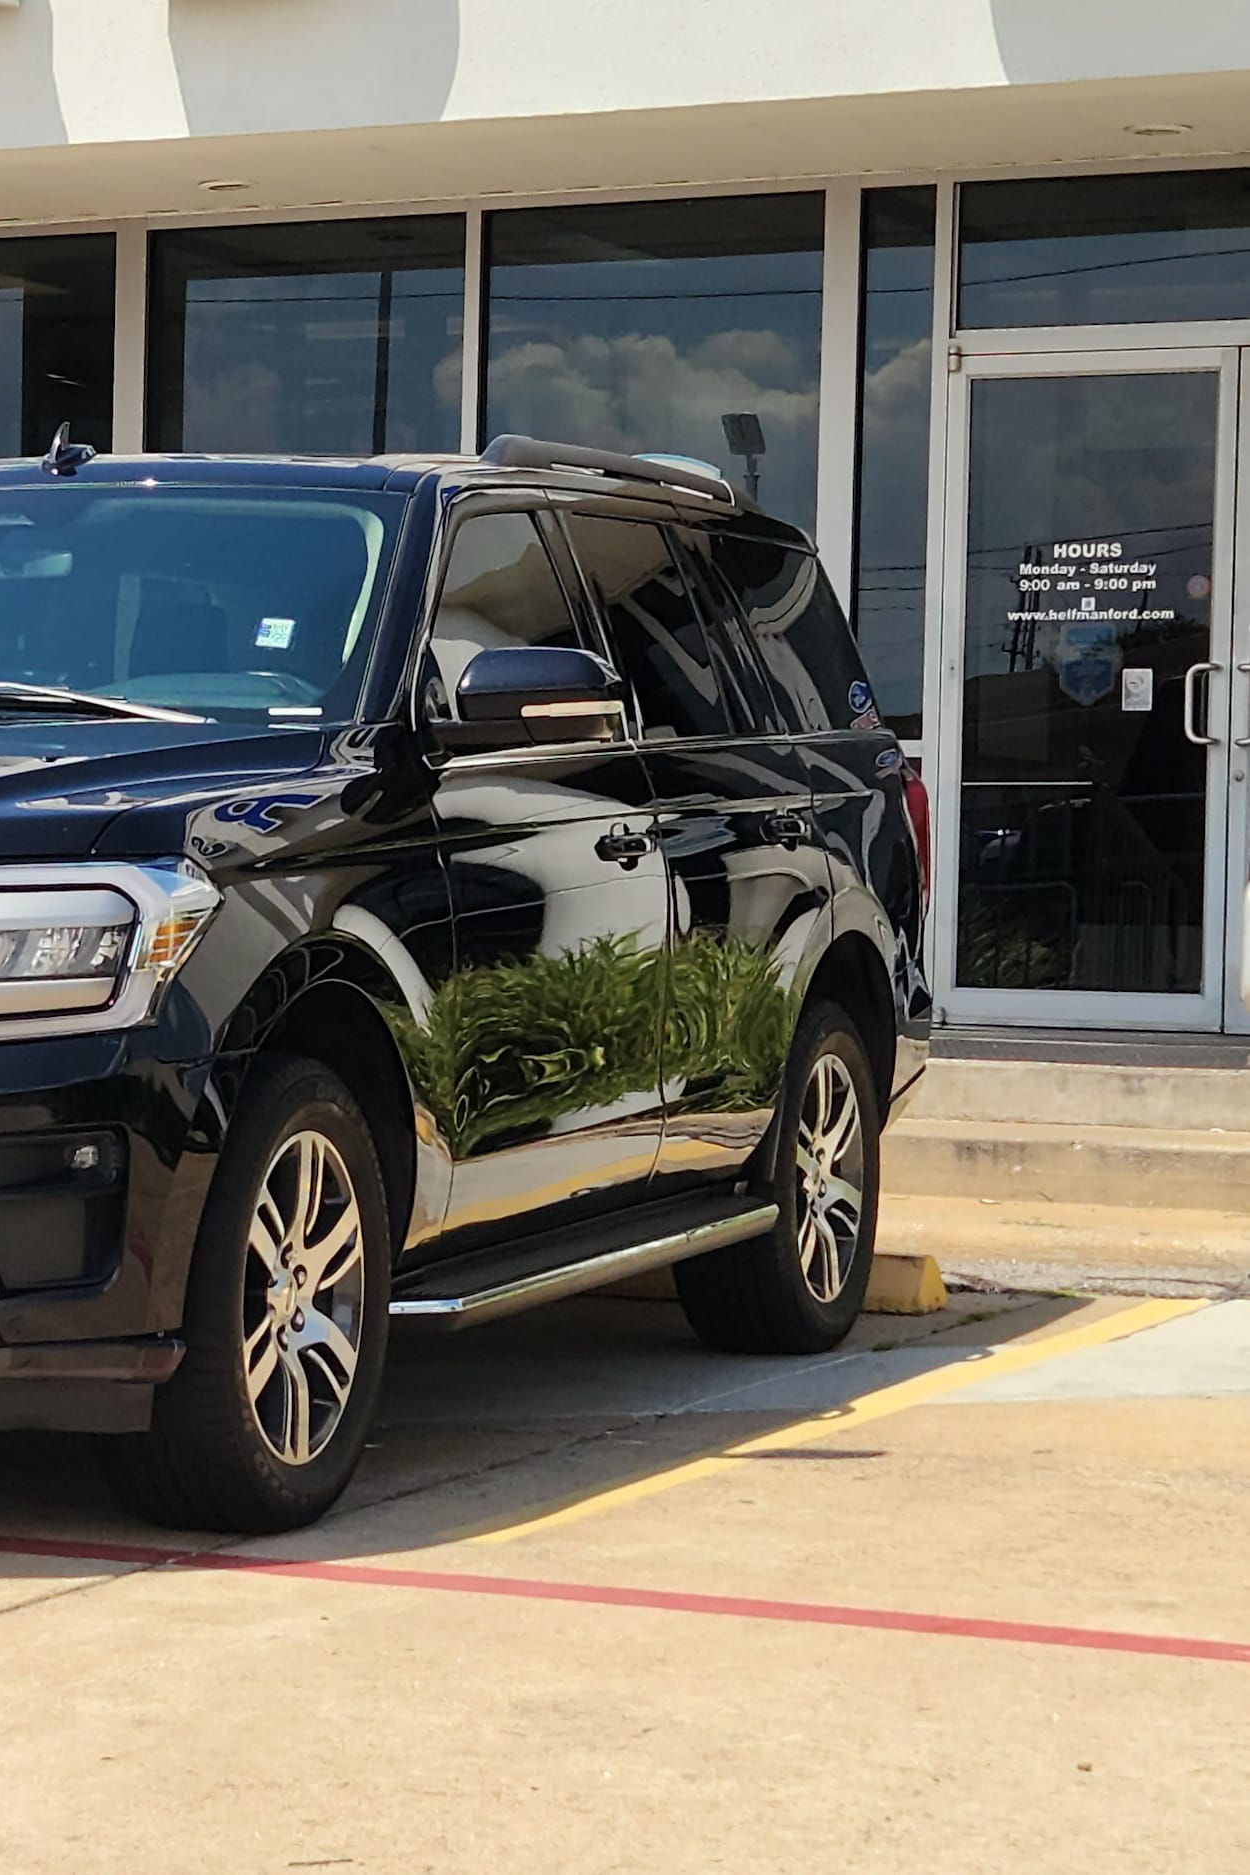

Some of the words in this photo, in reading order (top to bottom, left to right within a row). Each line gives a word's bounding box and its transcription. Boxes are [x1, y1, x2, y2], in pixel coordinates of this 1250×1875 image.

[1053, 542, 1122, 558] HOURS
[1019, 563, 1076, 577] Monday
[1089, 561, 1157, 576] Saturday
[1019, 579, 1050, 591] 9:00
[1056, 581, 1080, 590] am
[1094, 578, 1128, 590] 9:00
[1132, 579, 1157, 592] pm
[1007, 608, 1175, 621] www.helfmanford.com
